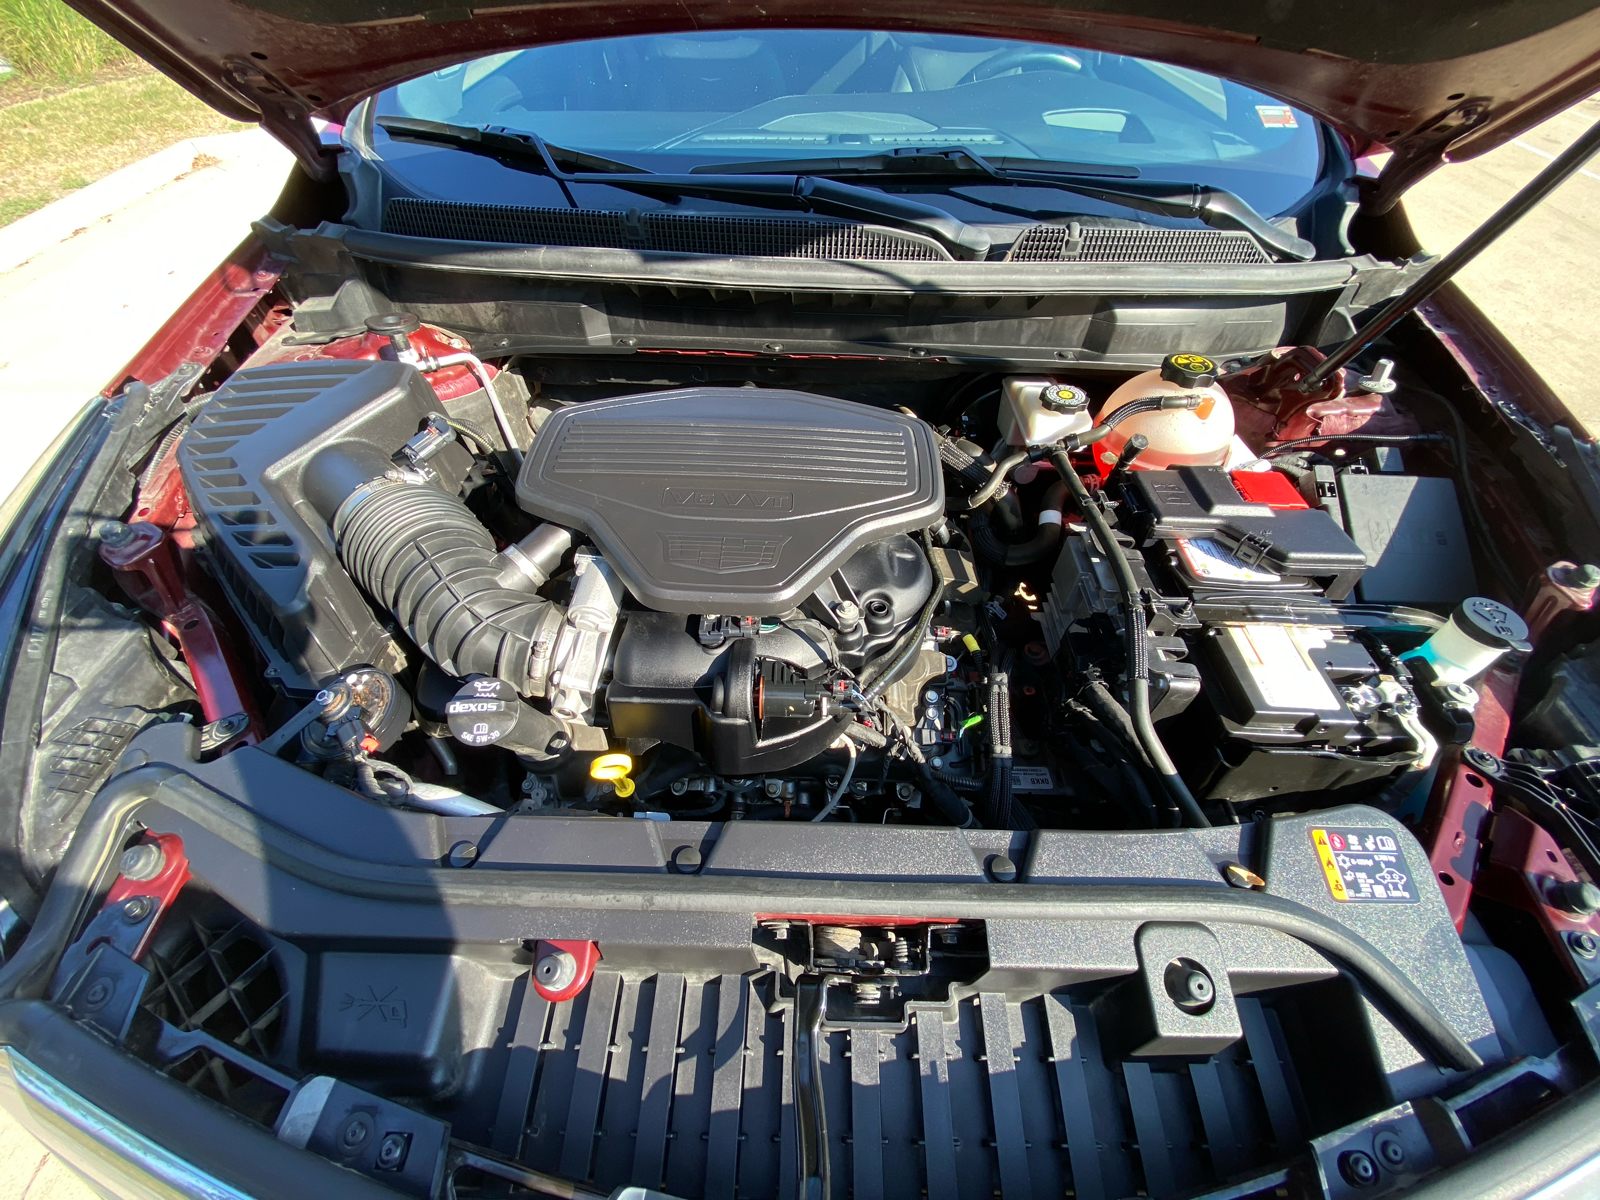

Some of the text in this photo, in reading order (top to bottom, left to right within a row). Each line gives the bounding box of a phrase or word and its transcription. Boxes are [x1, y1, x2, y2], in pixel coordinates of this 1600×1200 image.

[670, 491, 789, 508] V6 VVT
[449, 701, 499, 714] dexos
[461, 730, 500, 743] SAE 5W-30
